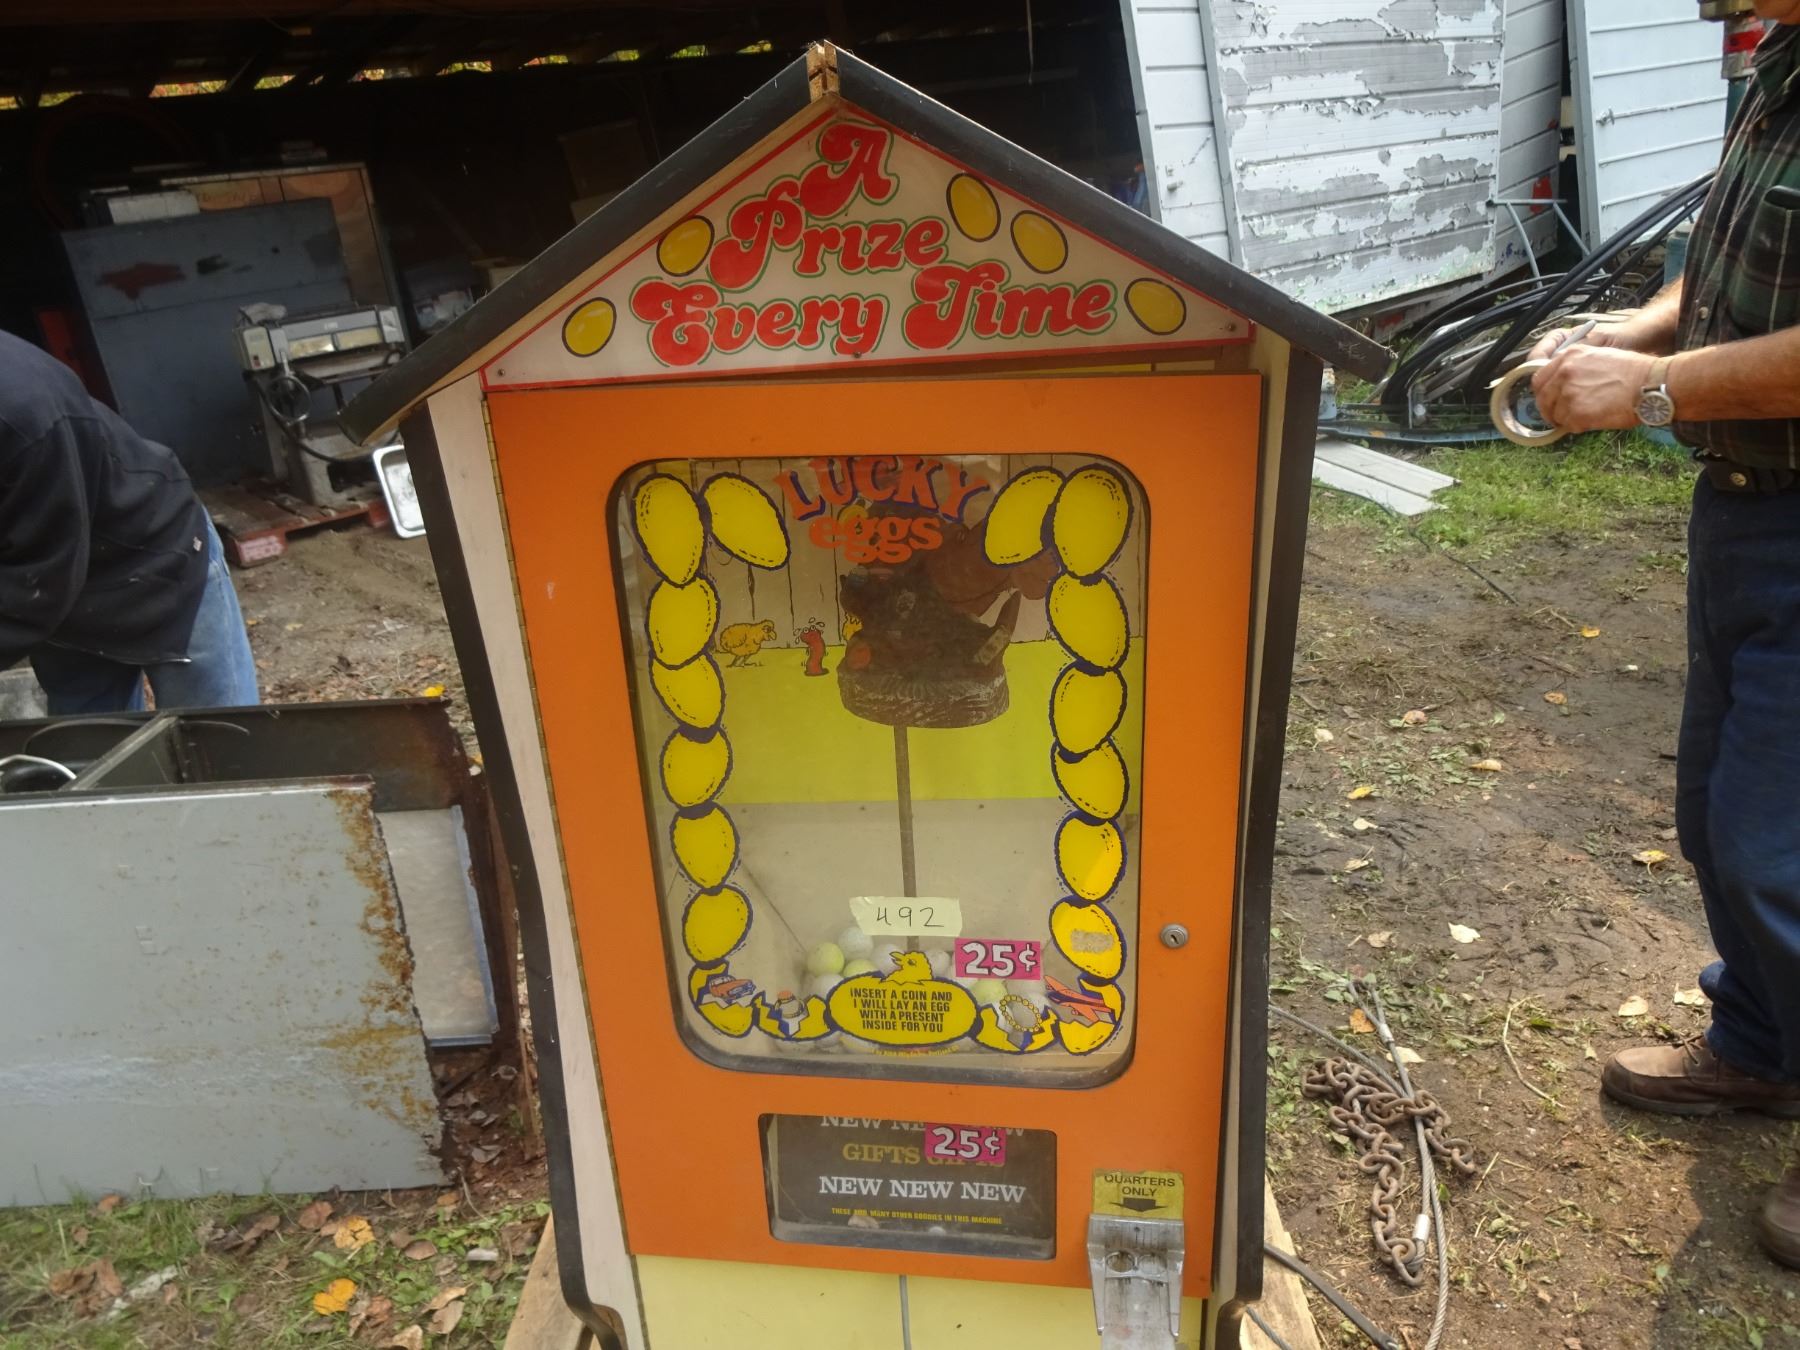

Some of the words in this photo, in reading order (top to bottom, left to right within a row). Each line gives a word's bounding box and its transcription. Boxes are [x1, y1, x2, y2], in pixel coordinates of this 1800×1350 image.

[800, 121, 896, 218] A
[708, 176, 947, 291] Prize
[630, 278, 888, 367] Every
[902, 260, 1116, 350] Time
[774, 456, 991, 523] LUCKY
[809, 516, 943, 564] eggs
[876, 906, 945, 928] 492
[962, 941, 1038, 977] 25¢
[850, 988, 887, 999] INSERT
[890, 989, 897, 999] A
[901, 990, 927, 1000] COIN
[931, 991, 952, 1001] AND
[853, 999, 857, 1008] I
[861, 999, 887, 1009] WILL
[890, 1000, 909, 1010] LAY
[912, 1001, 926, 1011] AN
[930, 1002, 950, 1012] EGG
[860, 1009, 886, 1020] WITH
[890, 1010, 896, 1020] A
[899, 1011, 944, 1022] PRESENT
[863, 1020, 897, 1031] INSIDE
[901, 1021, 920, 1032] FOR
[922, 1022, 943, 1033] YOU
[842, 1143, 920, 1165] GIFTS
[932, 1126, 1001, 1158] 25¢
[819, 1176, 883, 1196] NEW
[889, 1179, 954, 1199] NEW
[960, 1182, 1027, 1203] NEW
[1104, 1174, 1176, 1188] QUARTERS
[1122, 1186, 1158, 1197] ONLY
